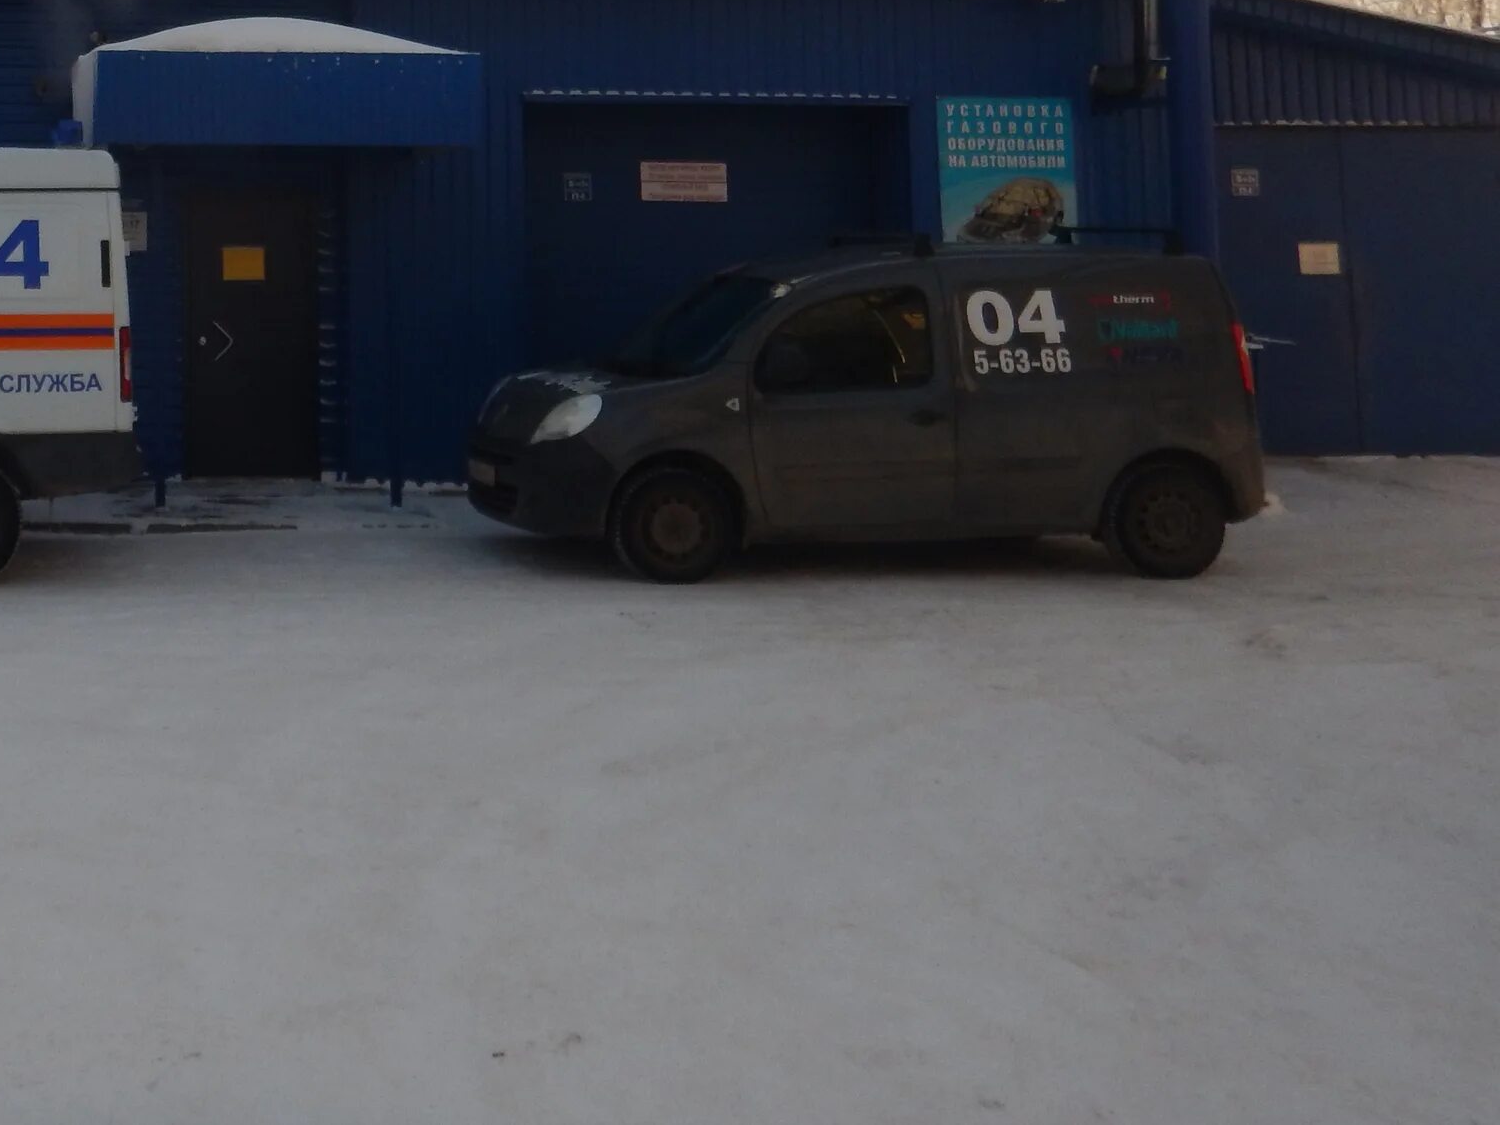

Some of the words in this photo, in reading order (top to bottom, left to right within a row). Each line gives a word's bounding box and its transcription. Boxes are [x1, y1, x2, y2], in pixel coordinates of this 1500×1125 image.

[946, 104, 1063, 117] УСТАНОВКА
[946, 121, 1064, 135] ГАЗОВОГО
[947, 138, 1065, 152] ОБОРУДОВАНИЯ
[948, 155, 966, 167] НА
[971, 155, 1066, 168] АВТОМОБИЛИ
[966, 289, 1067, 346] 04
[973, 348, 1072, 374] 5-63-66
